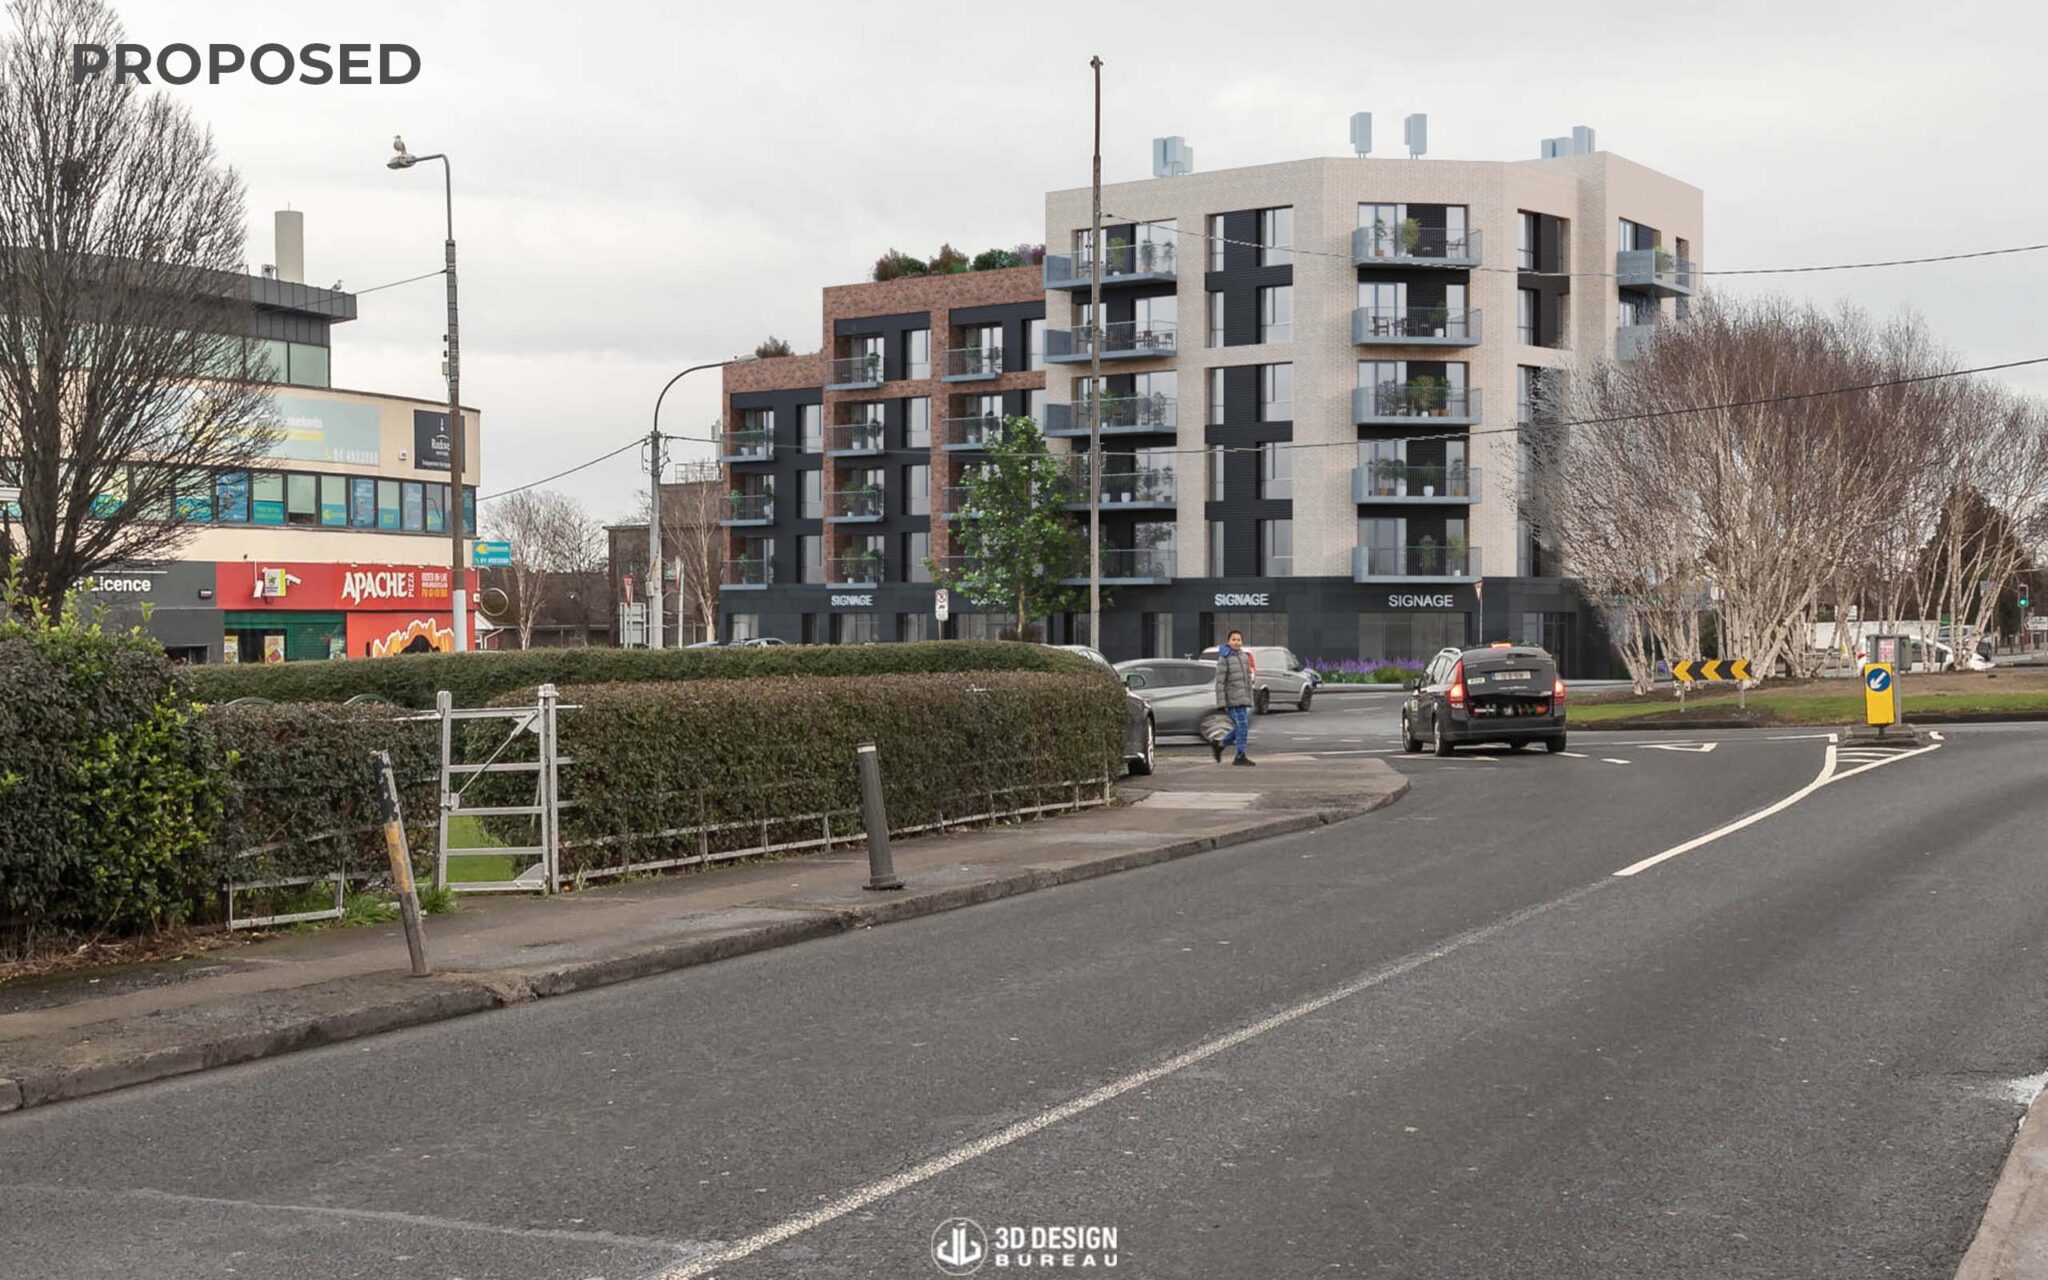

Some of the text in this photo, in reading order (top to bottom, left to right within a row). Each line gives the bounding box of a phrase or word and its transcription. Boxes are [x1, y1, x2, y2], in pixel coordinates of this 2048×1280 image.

[341, 571, 409, 606] APACHE
[831, 594, 874, 607] SIGNAGE
[1214, 593, 1270, 607] SIGNAGE
[1388, 594, 1454, 608] SIGNAGE
